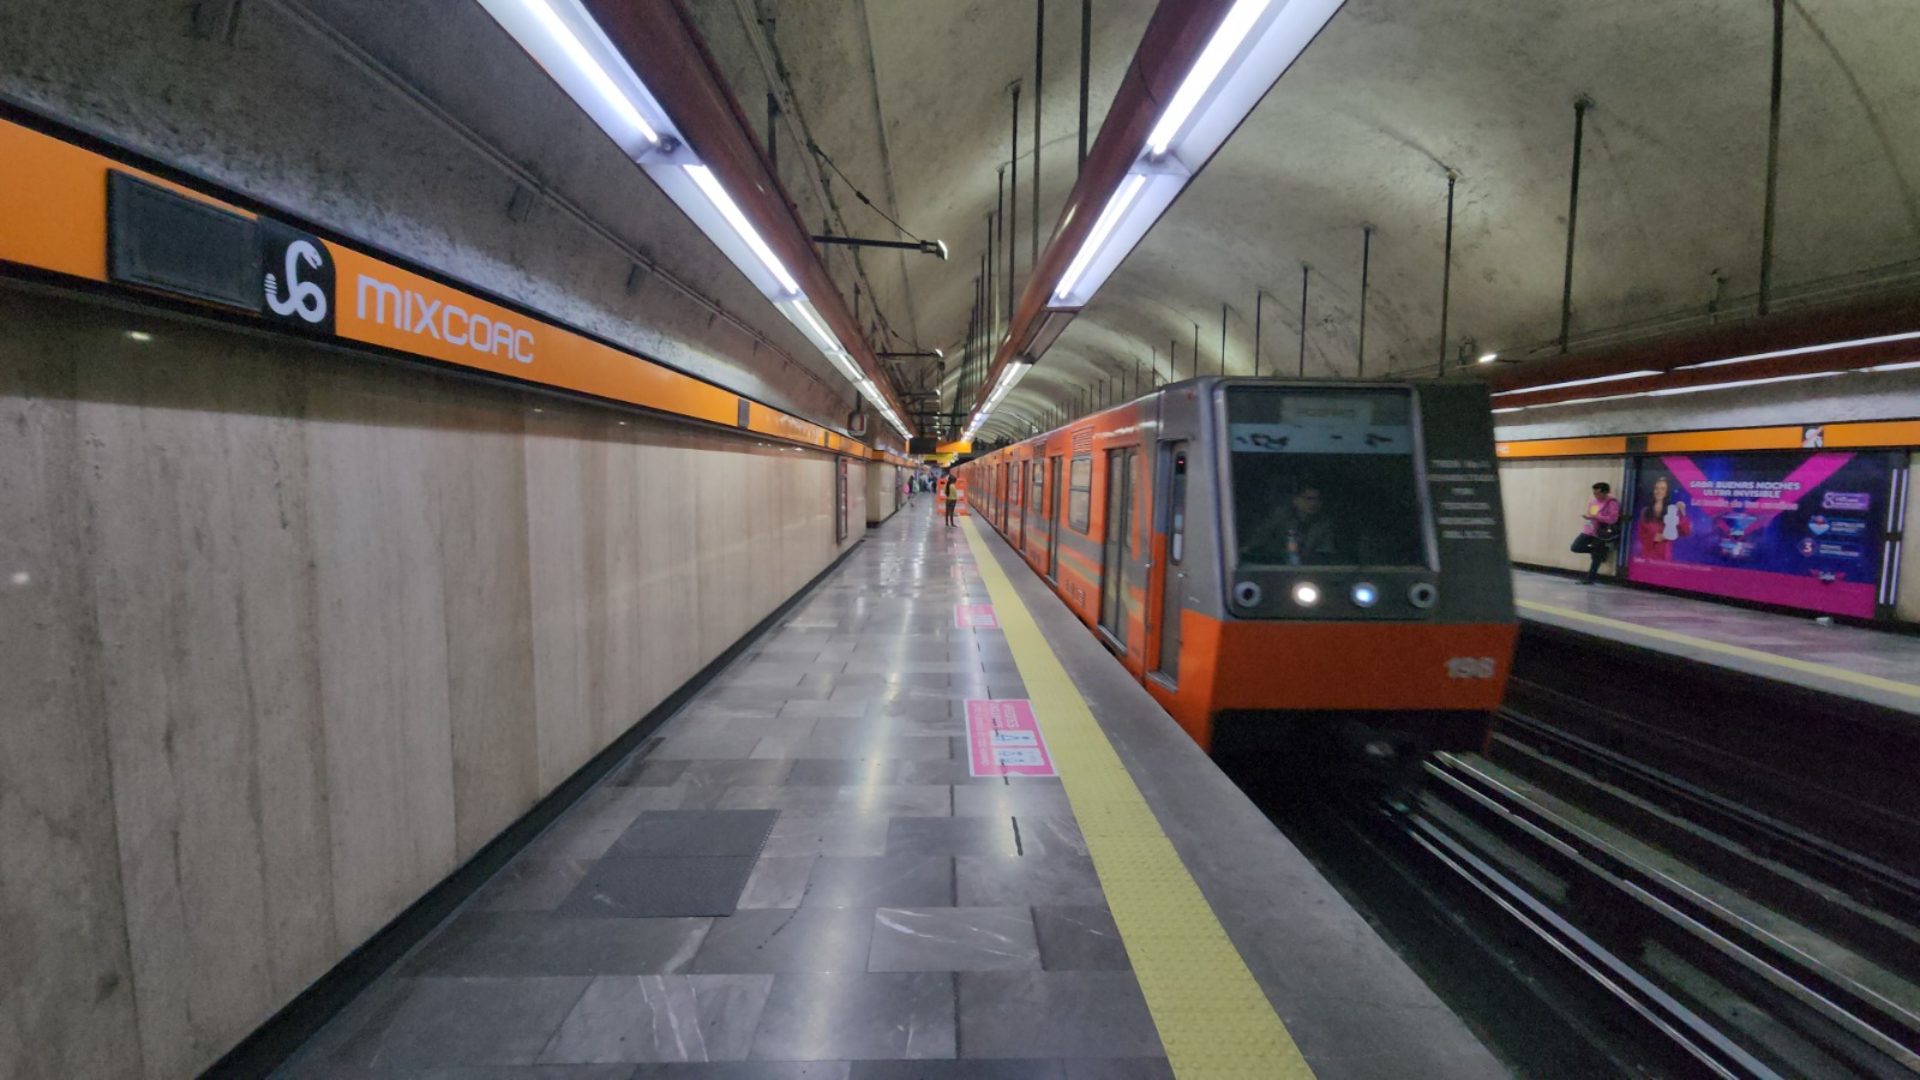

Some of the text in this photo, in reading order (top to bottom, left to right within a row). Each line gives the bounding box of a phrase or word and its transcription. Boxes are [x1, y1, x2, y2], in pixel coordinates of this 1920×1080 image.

[357, 274, 535, 364] MIXCOAC
[1716, 481, 1754, 489] BUENAS
[1755, 481, 1801, 490] NOCHES
[1732, 489, 1782, 498] INVISIBLE
[1803, 542, 1812, 553] 3
